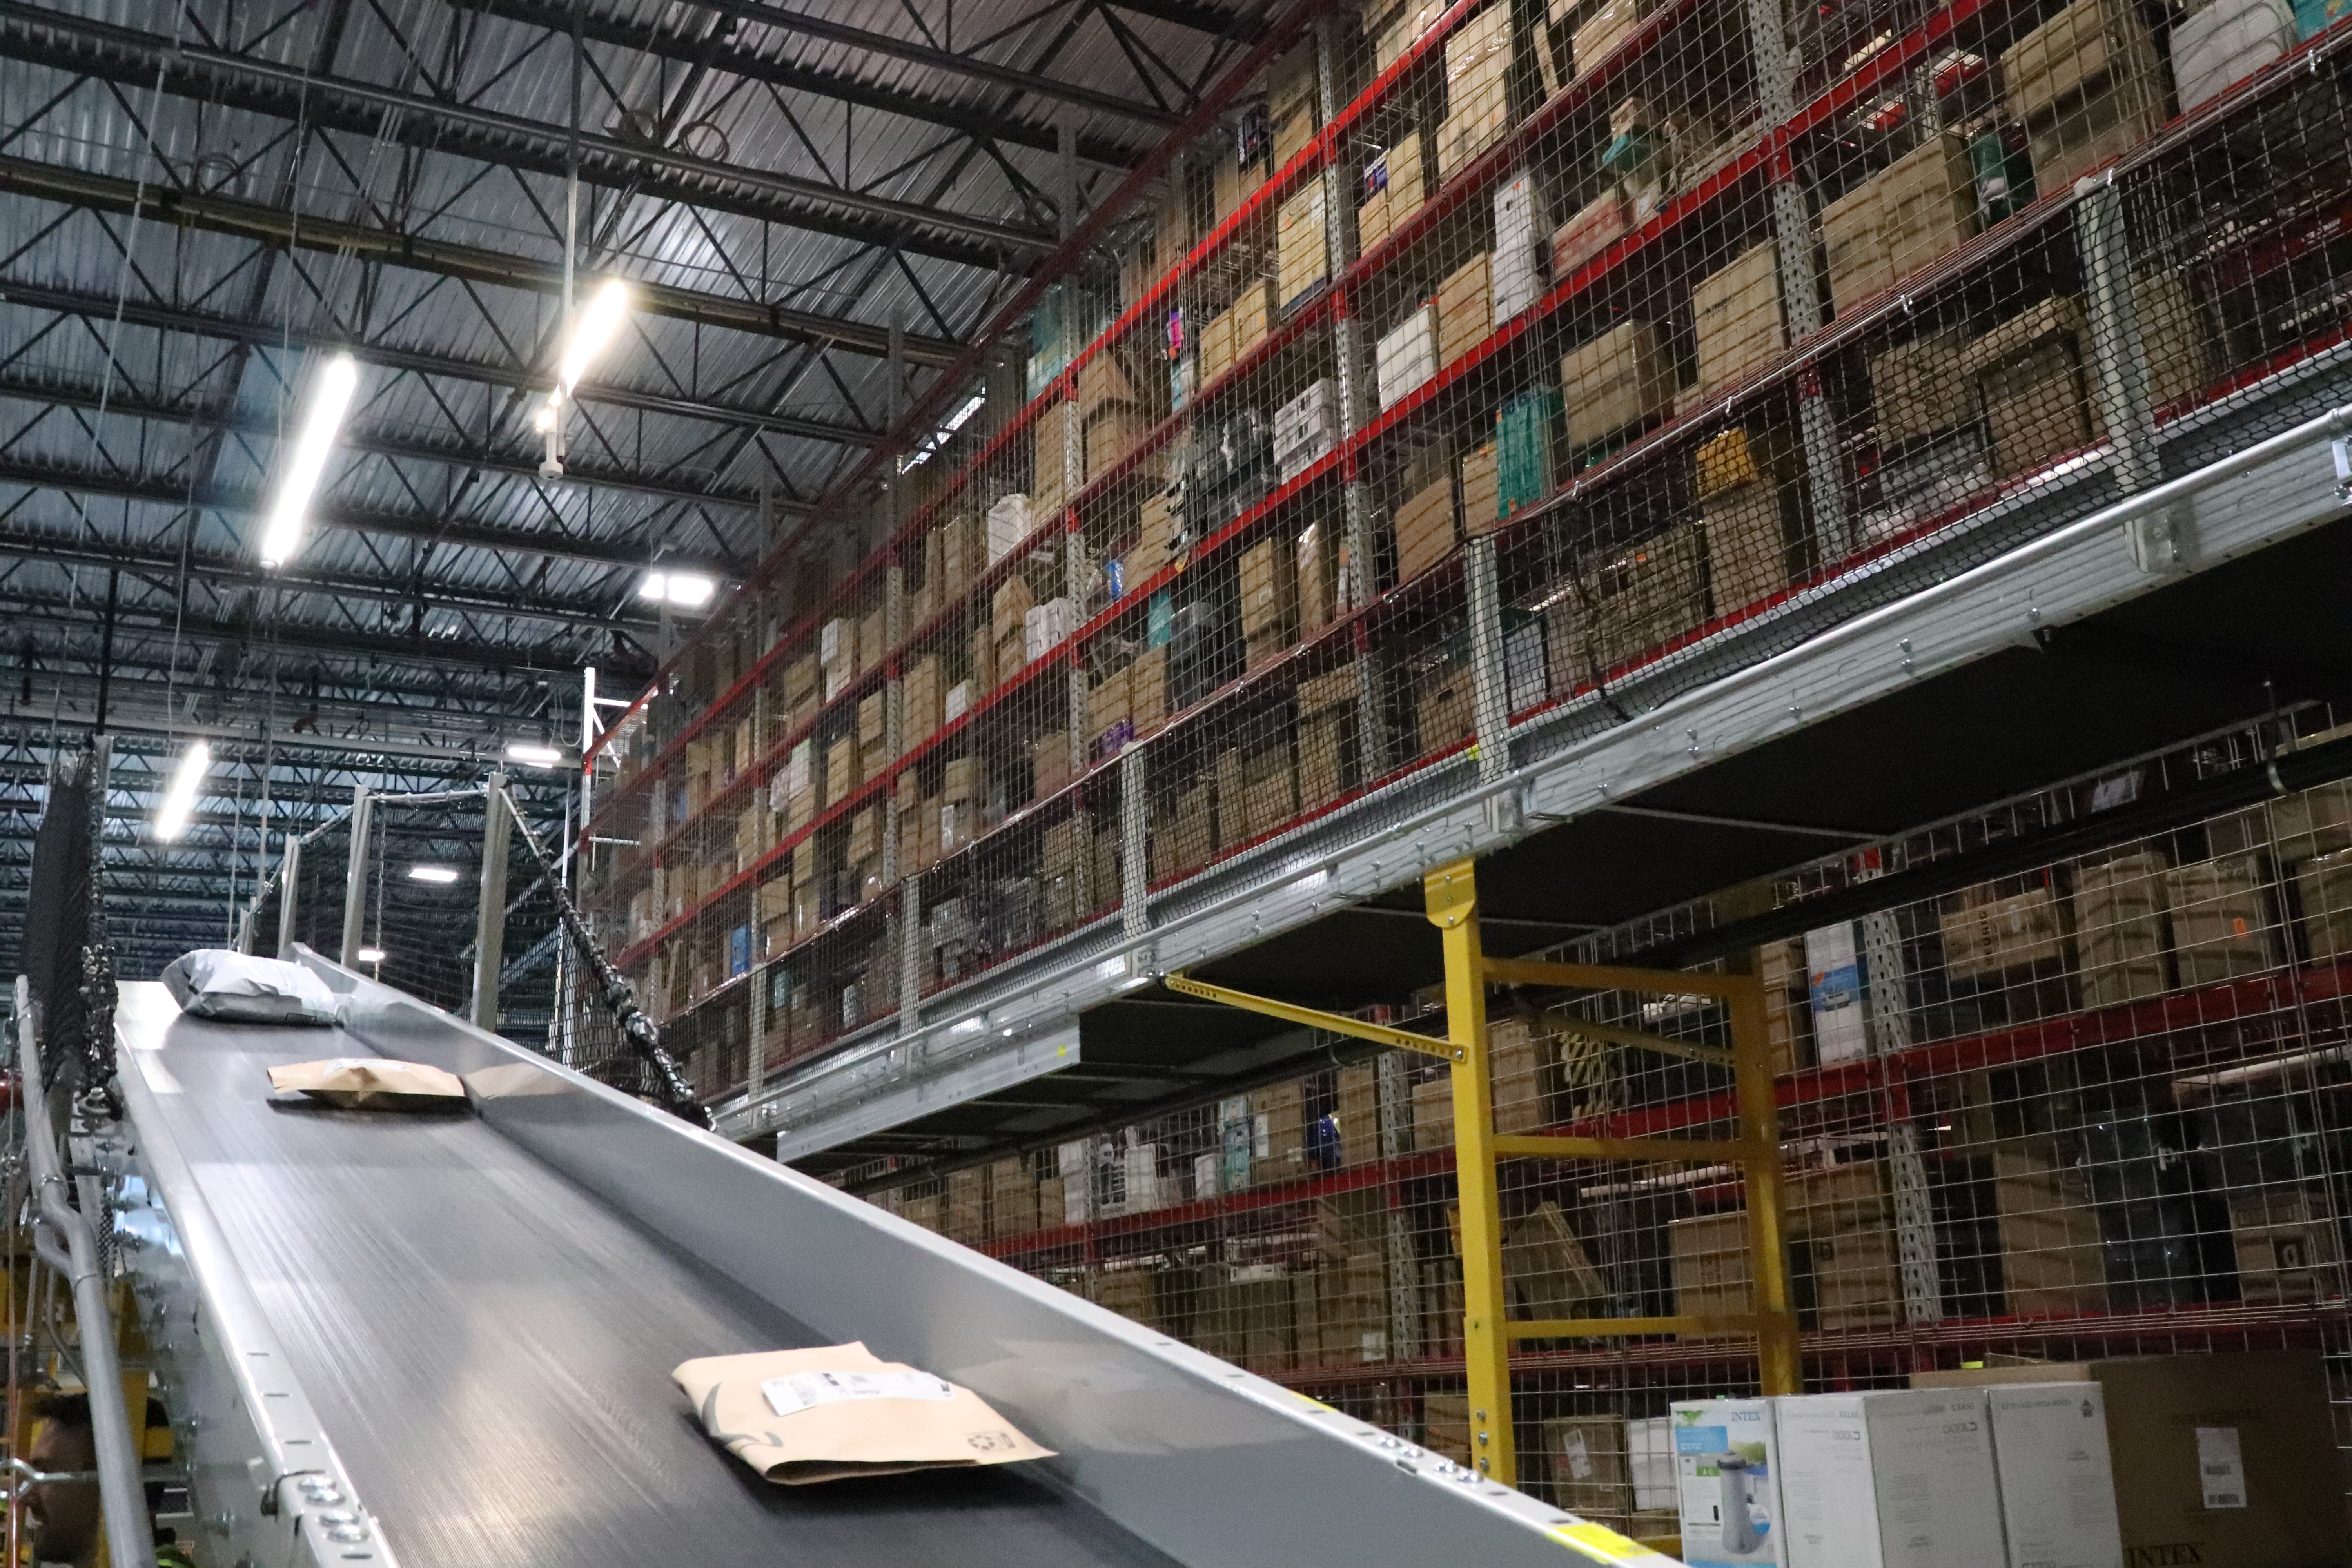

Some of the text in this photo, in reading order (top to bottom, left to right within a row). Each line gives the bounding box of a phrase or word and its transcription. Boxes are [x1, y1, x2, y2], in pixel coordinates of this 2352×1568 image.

[1979, 911, 1993, 966] KEURIG
[1732, 1411, 1761, 1422] INTEX
[2131, 1543, 2205, 1568] INTEX
